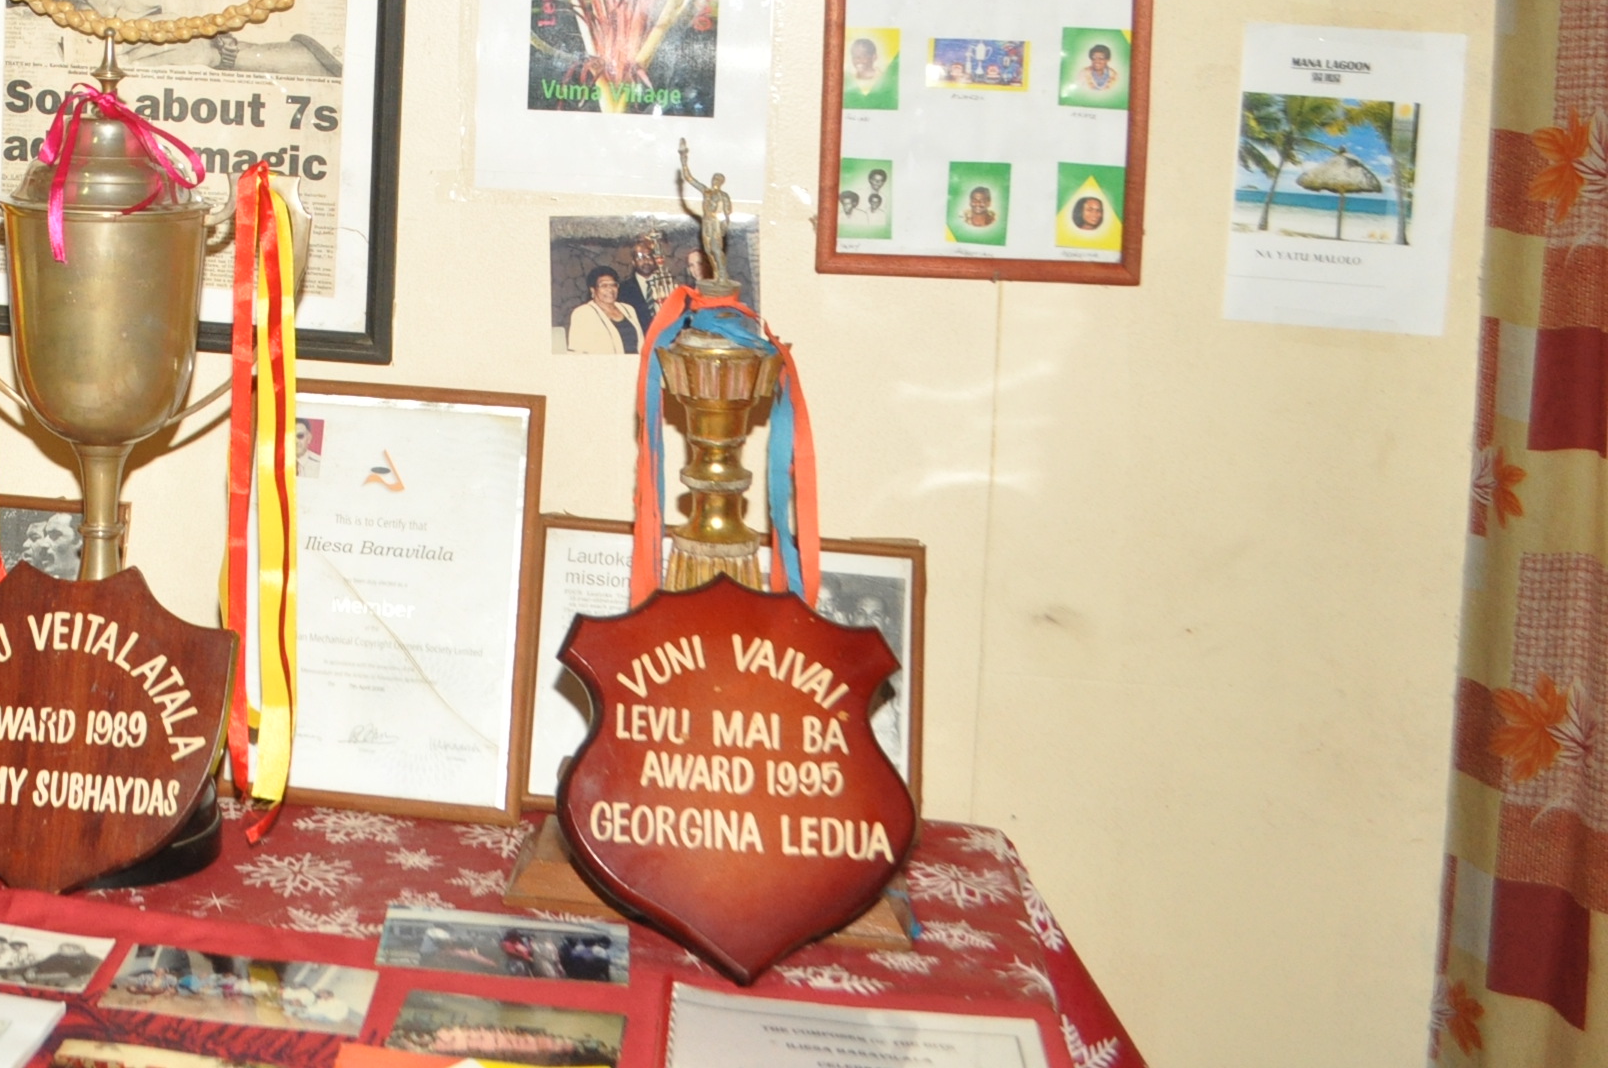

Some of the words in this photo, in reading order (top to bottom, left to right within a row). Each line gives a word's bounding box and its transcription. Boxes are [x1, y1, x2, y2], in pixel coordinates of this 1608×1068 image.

[5, 79, 96, 118] Son
[134, 87, 266, 128] about
[285, 94, 339, 133] 7s
[542, 79, 601, 102] Vuma
[608, 81, 682, 107] Village
[192, 145, 328, 182] magic
[335, 513, 352, 526] This
[355, 516, 362, 526] is
[365, 517, 375, 527] to
[377, 516, 406, 532] Certify
[409, 519, 428, 532] that
[304, 535, 354, 554] Iliesa
[359, 540, 455, 562] Baravilala
[567, 547, 633, 569] Lautoka
[331, 597, 416, 619] Member
[309, 632, 353, 646] Mechanical
[354, 636, 392, 654] Copyright
[27, 611, 206, 763] VEITALATALA
[616, 633, 706, 699] VUNI
[731, 633, 850, 710] VAIVAI
[85, 709, 147, 748] 1989
[615, 702, 691, 744] LEVU
[712, 709, 780, 752] MAI
[802, 715, 850, 755] BA
[32, 768, 181, 817] SUBHAYDAS
[640, 751, 755, 795] AWARD
[766, 760, 845, 798] 1995
[590, 800, 764, 854] GEORGINA
[780, 813, 894, 864] LEDUA
